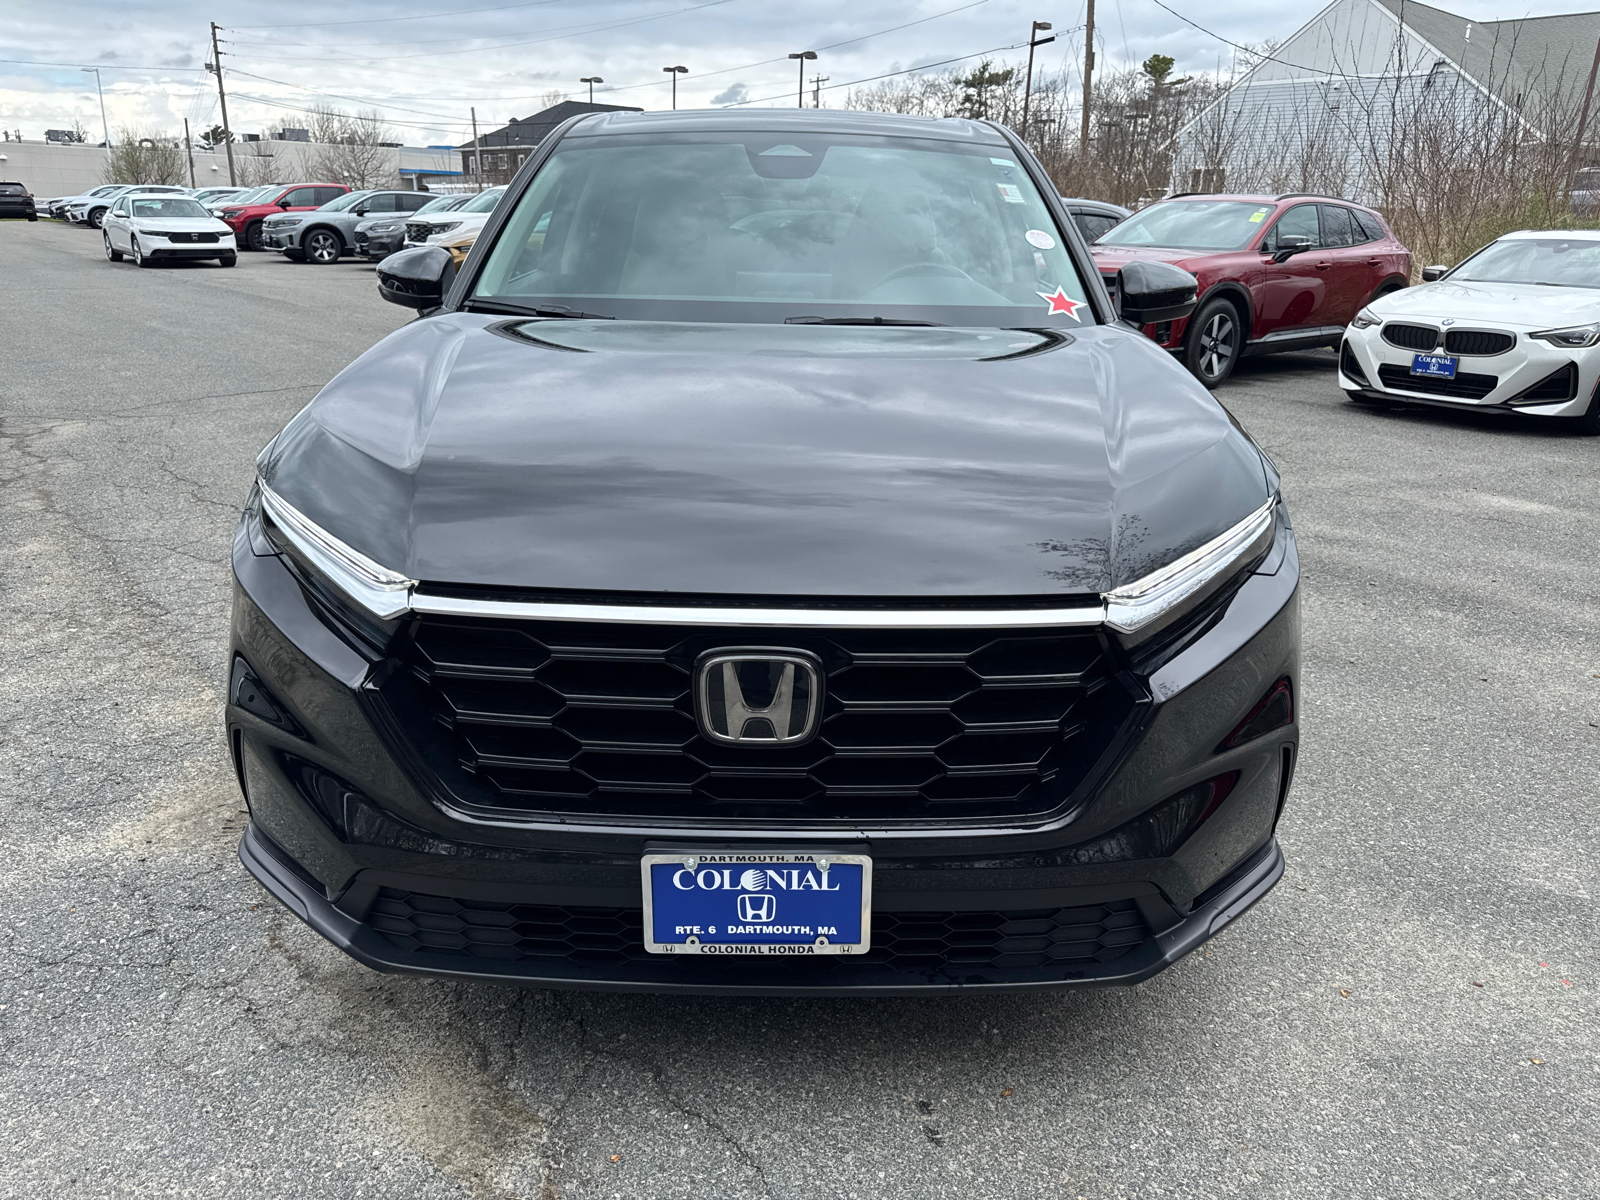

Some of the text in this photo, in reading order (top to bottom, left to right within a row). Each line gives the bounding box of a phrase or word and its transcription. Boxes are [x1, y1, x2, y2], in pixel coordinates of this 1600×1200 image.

[698, 855, 790, 863] DARTMOUTH,
[672, 868, 841, 892] COLONIAL
[675, 925, 838, 936] RTE. 6 DARTMOUTH, MA
[700, 945, 815, 954] COLONIAL HONDA
